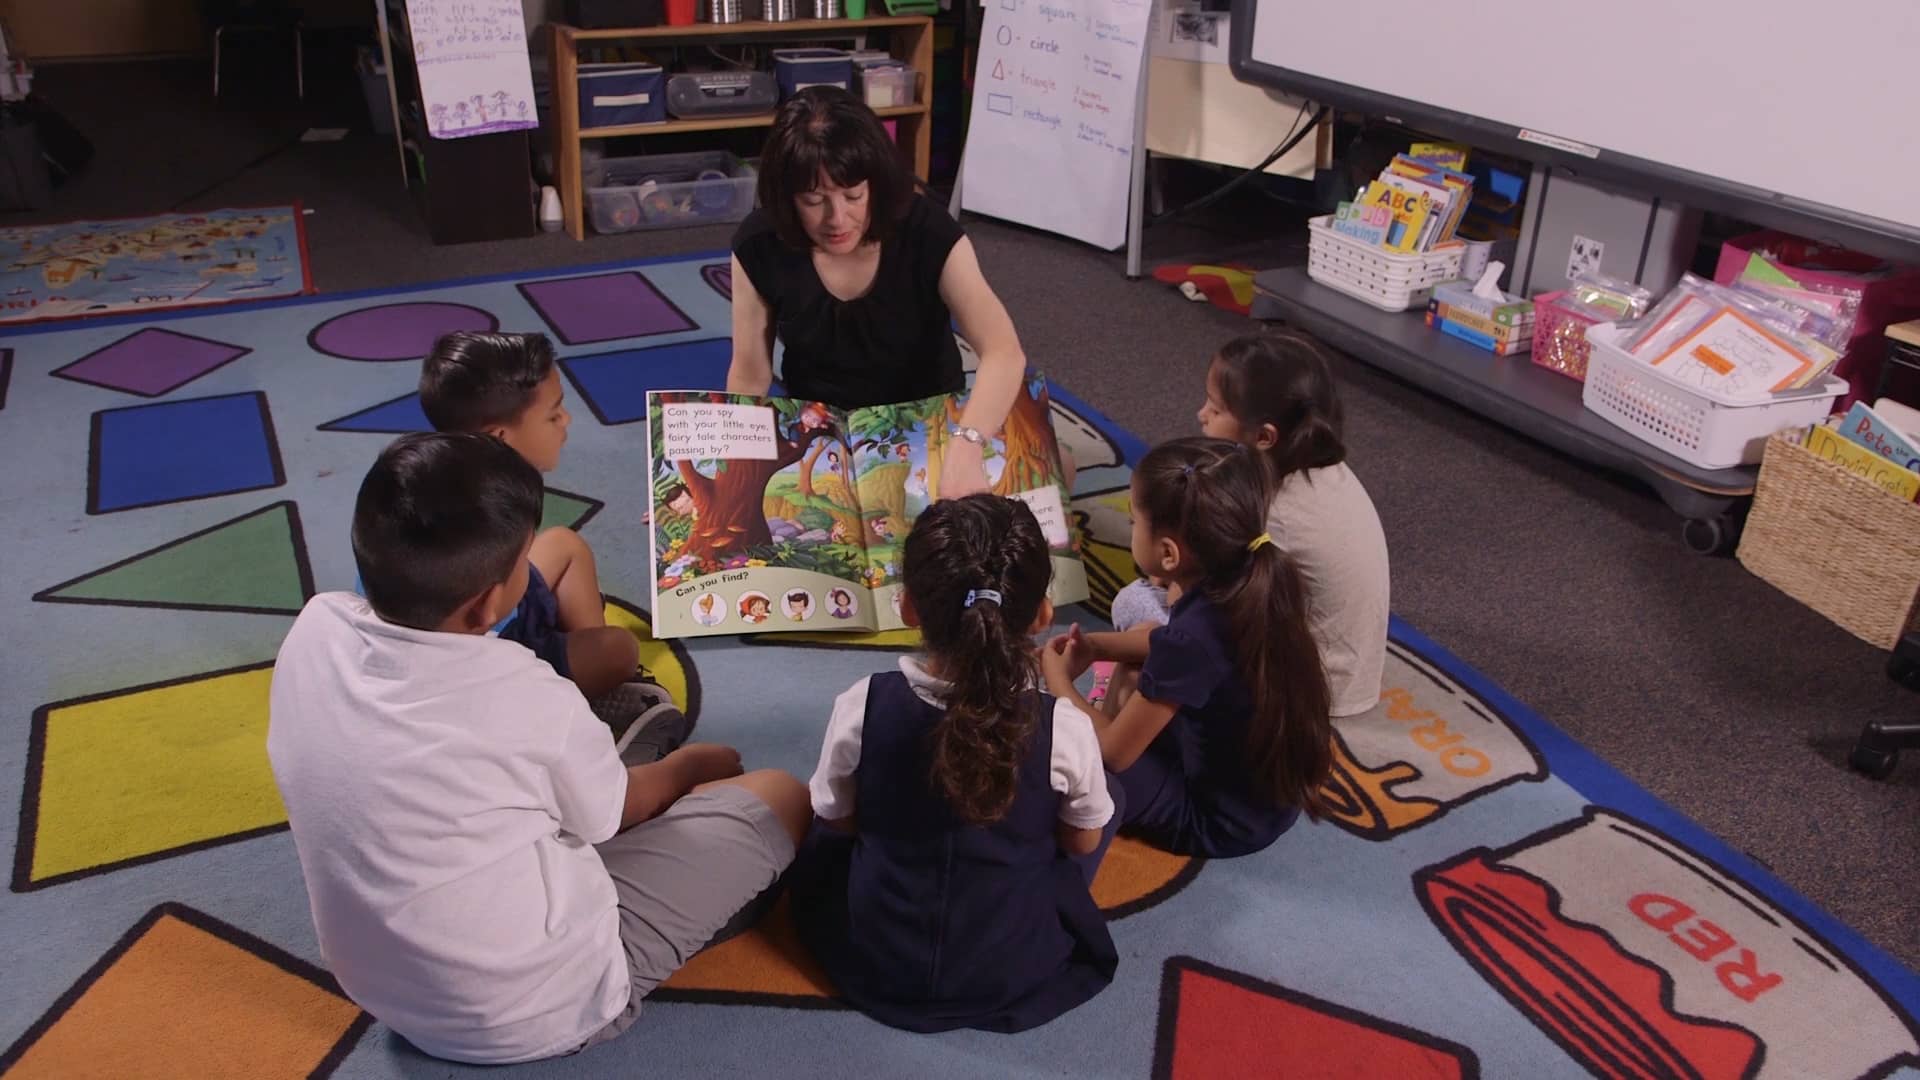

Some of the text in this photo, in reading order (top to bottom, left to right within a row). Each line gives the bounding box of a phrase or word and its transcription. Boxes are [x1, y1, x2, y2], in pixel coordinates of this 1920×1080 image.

[1030, 36, 1059, 53] circle
[1020, 67, 1056, 93] triangle
[1377, 189, 1417, 213] ABC
[668, 408, 733, 418] Can you spy
[668, 421, 689, 429] with
[695, 422, 717, 430] your
[723, 421, 744, 429] little
[1856, 416, 1909, 457] Pete the
[668, 433, 691, 443] fairy
[721, 433, 771, 442] characters
[669, 445, 730, 456] passing by?
[1820, 436, 1873, 476] David
[676, 571, 749, 597] Can you find?
[1627, 893, 1783, 1002] RED
